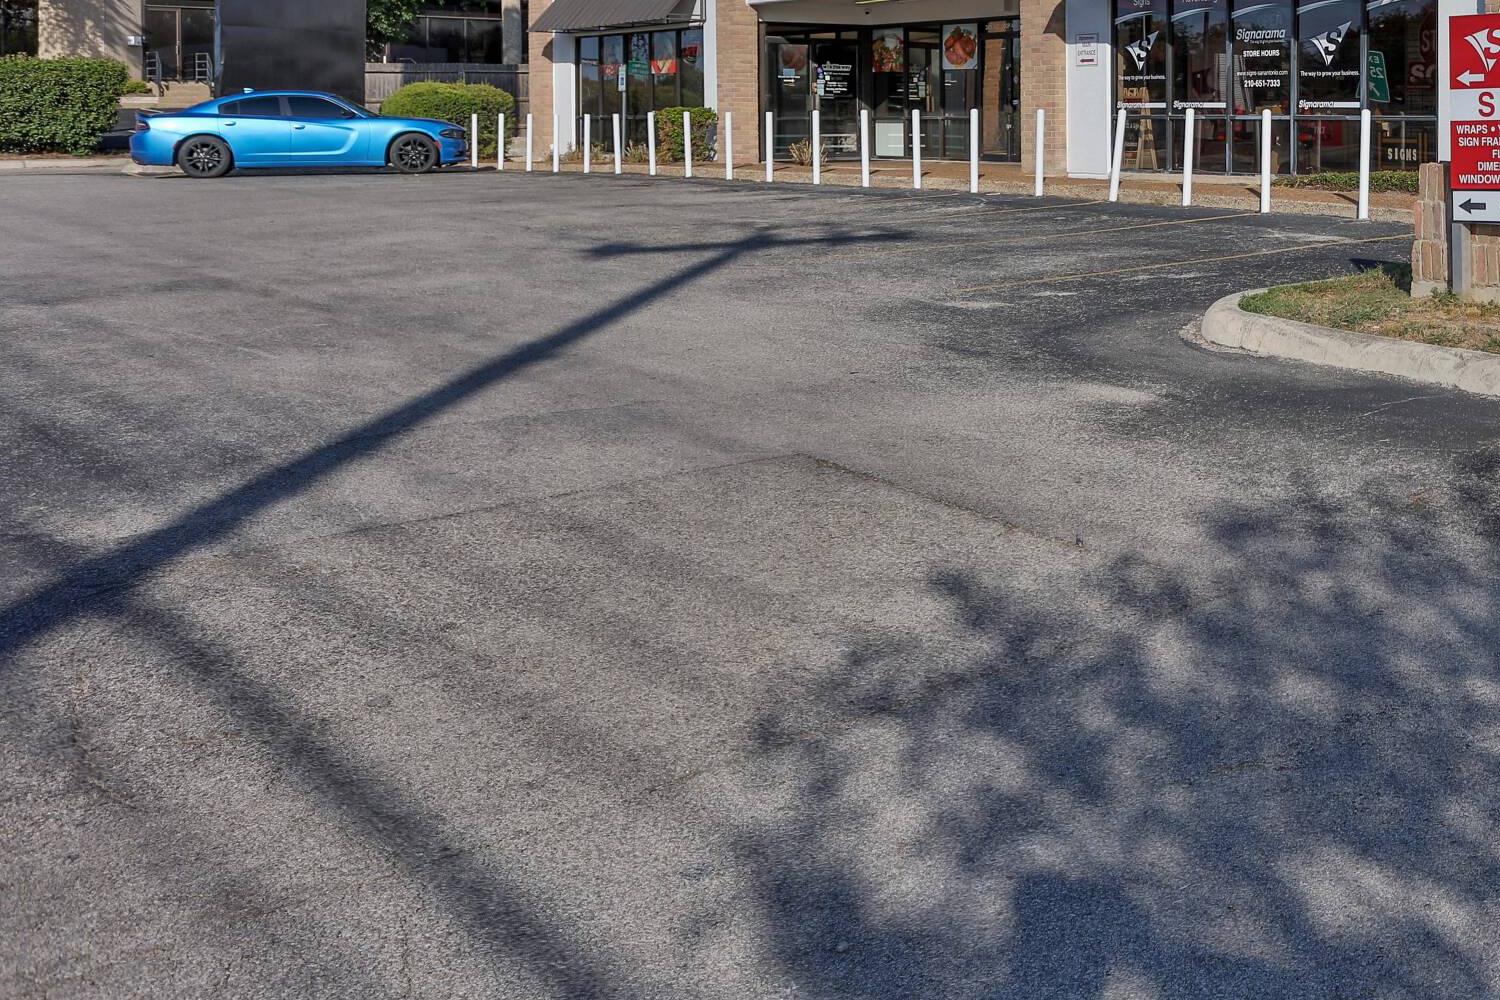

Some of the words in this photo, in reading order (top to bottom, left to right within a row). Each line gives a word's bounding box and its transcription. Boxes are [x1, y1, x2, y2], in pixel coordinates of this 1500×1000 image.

[1236, 29, 1285, 42] Signarama
[1243, 50, 1260, 58] STORE
[1244, 79, 1280, 87] 210-651-7333
[1173, 100, 1204, 109] Signarama
[1299, 100, 1334, 109] Signarama
[1456, 124, 1488, 134] WRAPS
[1458, 137, 1479, 146] SIGN
[1388, 148, 1417, 161] SIGNS
